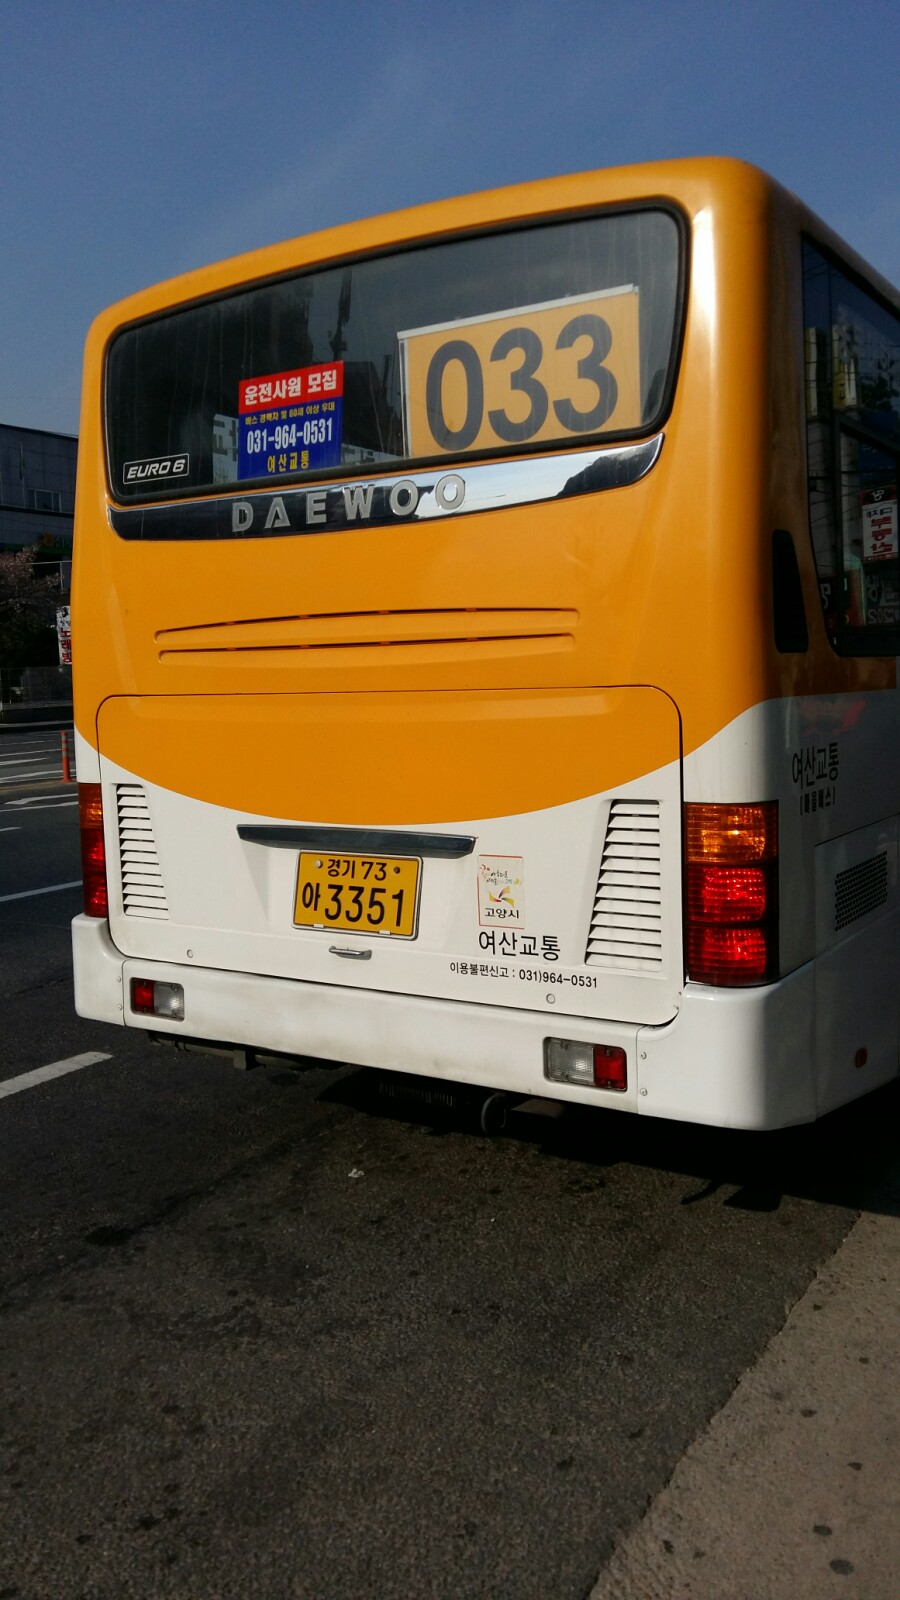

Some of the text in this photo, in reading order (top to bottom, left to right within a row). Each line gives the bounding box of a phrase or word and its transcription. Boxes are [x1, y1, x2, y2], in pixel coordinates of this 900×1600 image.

[245, 369, 337, 406] 운전사원 모집
[426, 314, 618, 451] 033
[247, 417, 333, 454] 031-964-0531
[126, 458, 185, 480] EURO 6
[231, 474, 466, 533] DAEWOO
[792, 742, 839, 790] 여산교통
[484, 907, 520, 919] 고양시
[478, 930, 561, 961] 여산교통
[519, 969, 598, 988] 031)964-0531
